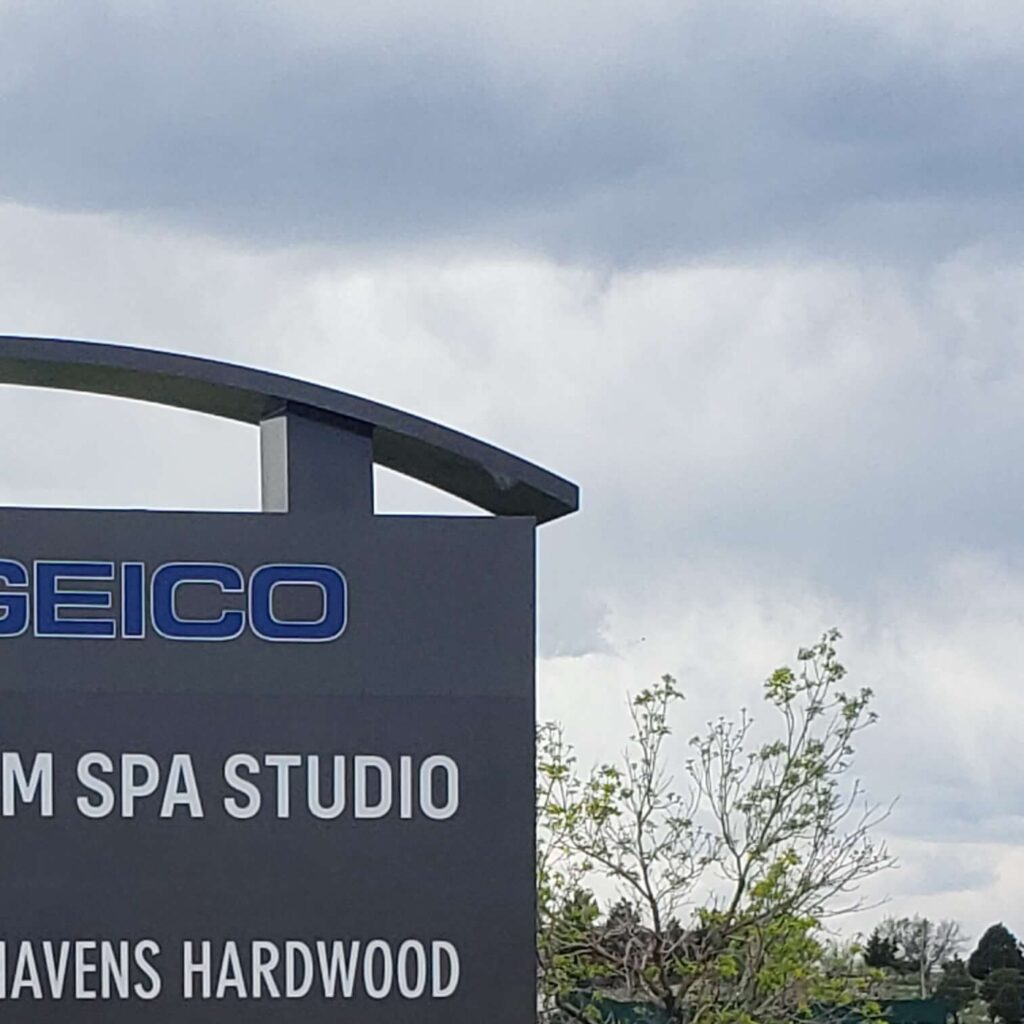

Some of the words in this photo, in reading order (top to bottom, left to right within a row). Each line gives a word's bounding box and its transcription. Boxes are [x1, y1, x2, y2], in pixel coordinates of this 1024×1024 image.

[76, 752, 205, 820] SPA
[224, 754, 460, 821] STUDIO
[184, 939, 461, 1000] HARDWOOD
